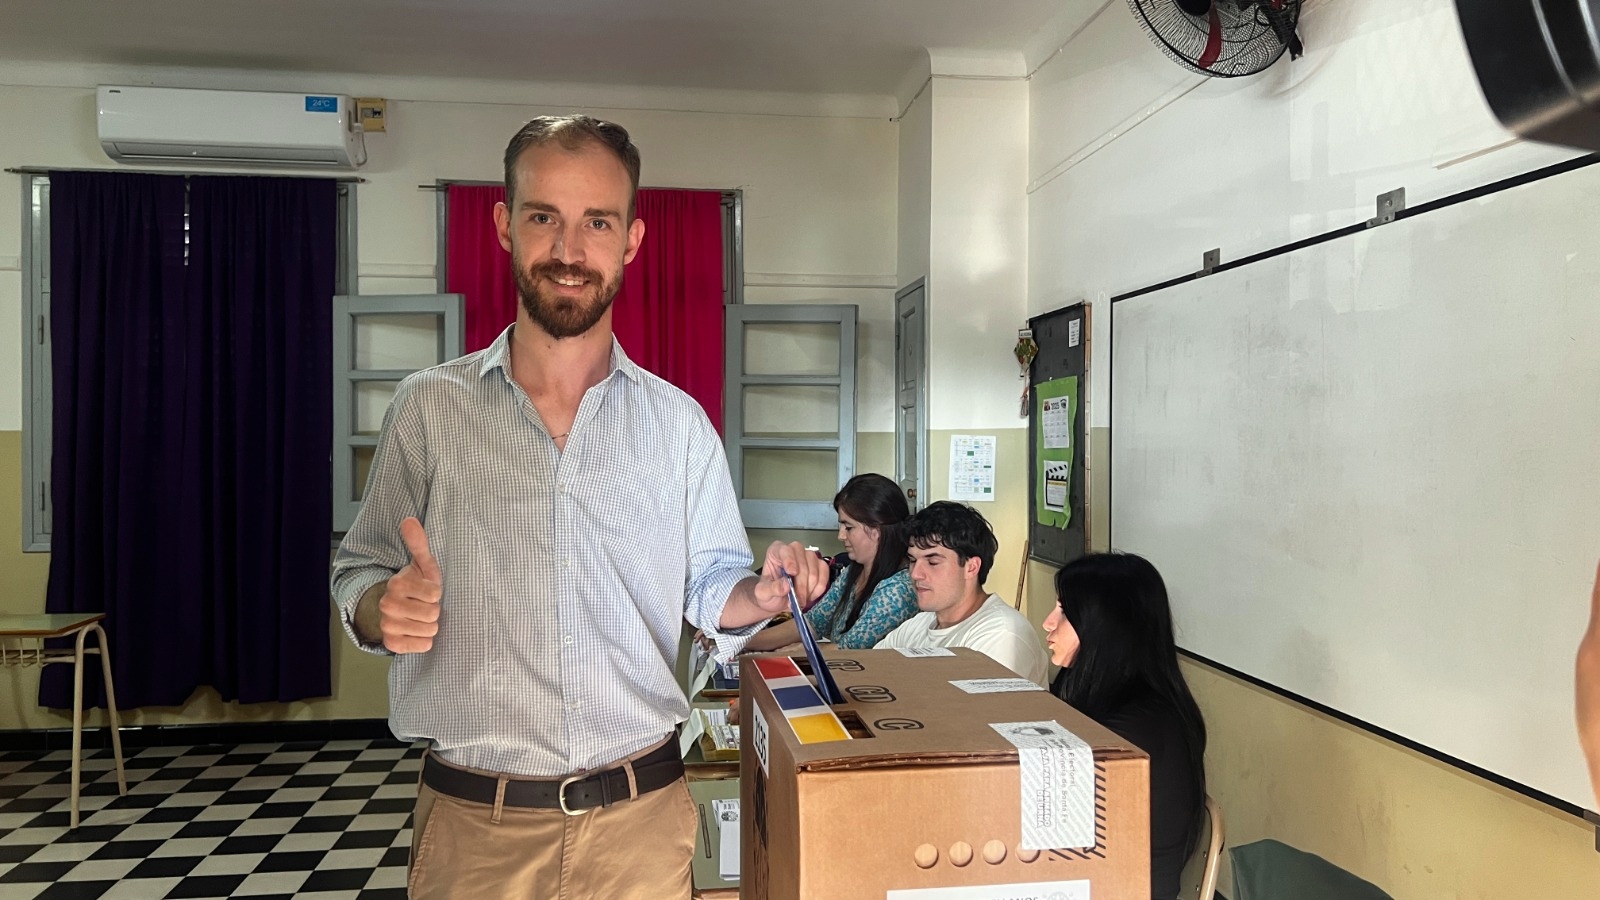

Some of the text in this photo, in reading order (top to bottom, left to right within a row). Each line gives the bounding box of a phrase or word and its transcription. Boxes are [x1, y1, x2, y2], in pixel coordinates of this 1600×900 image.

[845, 685, 897, 703] CD
[873, 717, 925, 731] C
[1043, 789, 1051, 828] ARMADO
